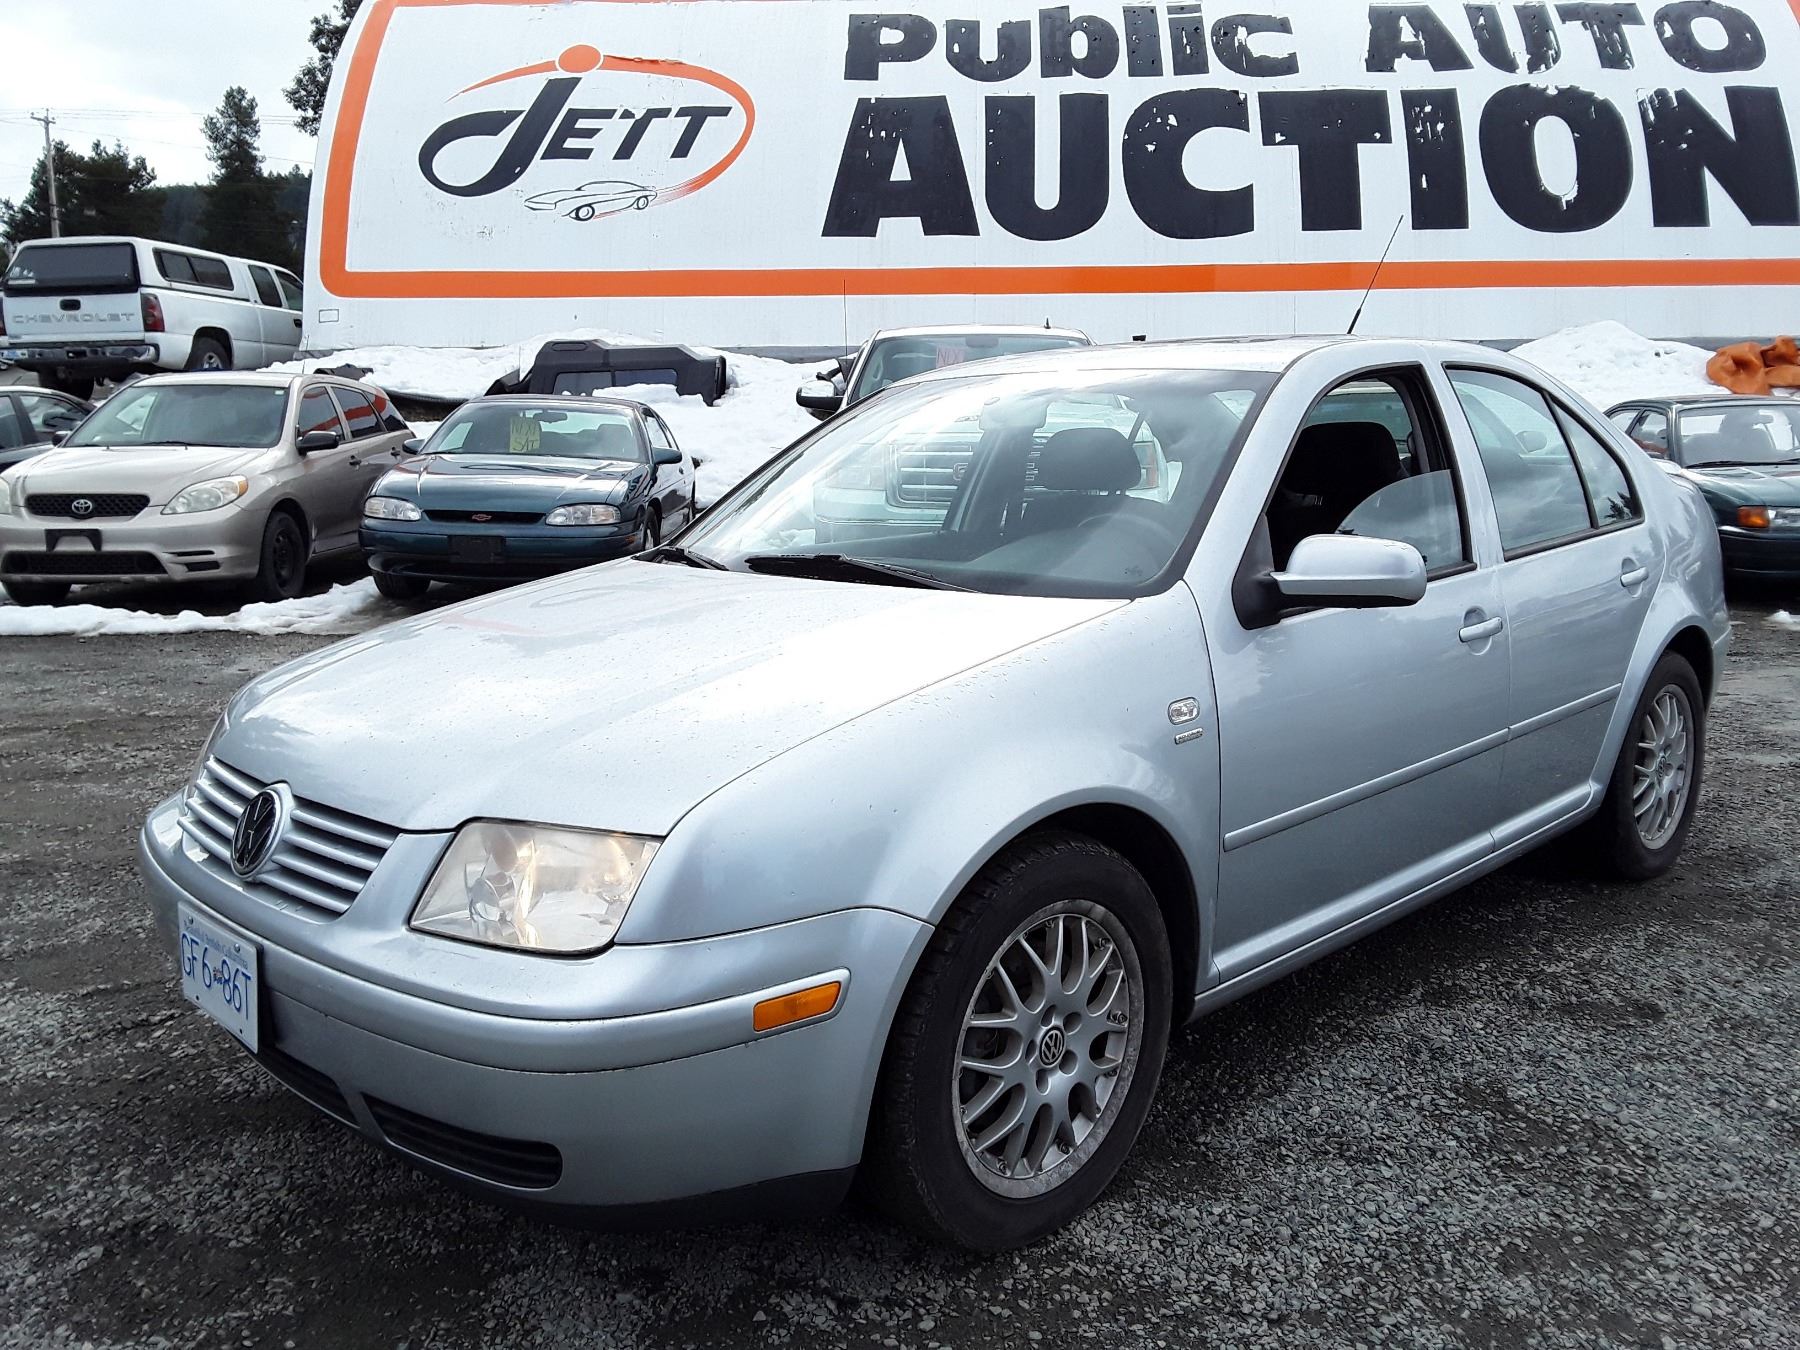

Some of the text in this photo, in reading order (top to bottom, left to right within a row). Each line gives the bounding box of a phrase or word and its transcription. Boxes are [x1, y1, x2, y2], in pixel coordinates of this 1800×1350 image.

[1364, 0, 1767, 75] AUTO
[418, 76, 733, 198] JETT
[821, 84, 1800, 241] AUCTION
[12, 312, 136, 324] CHEVROLET
